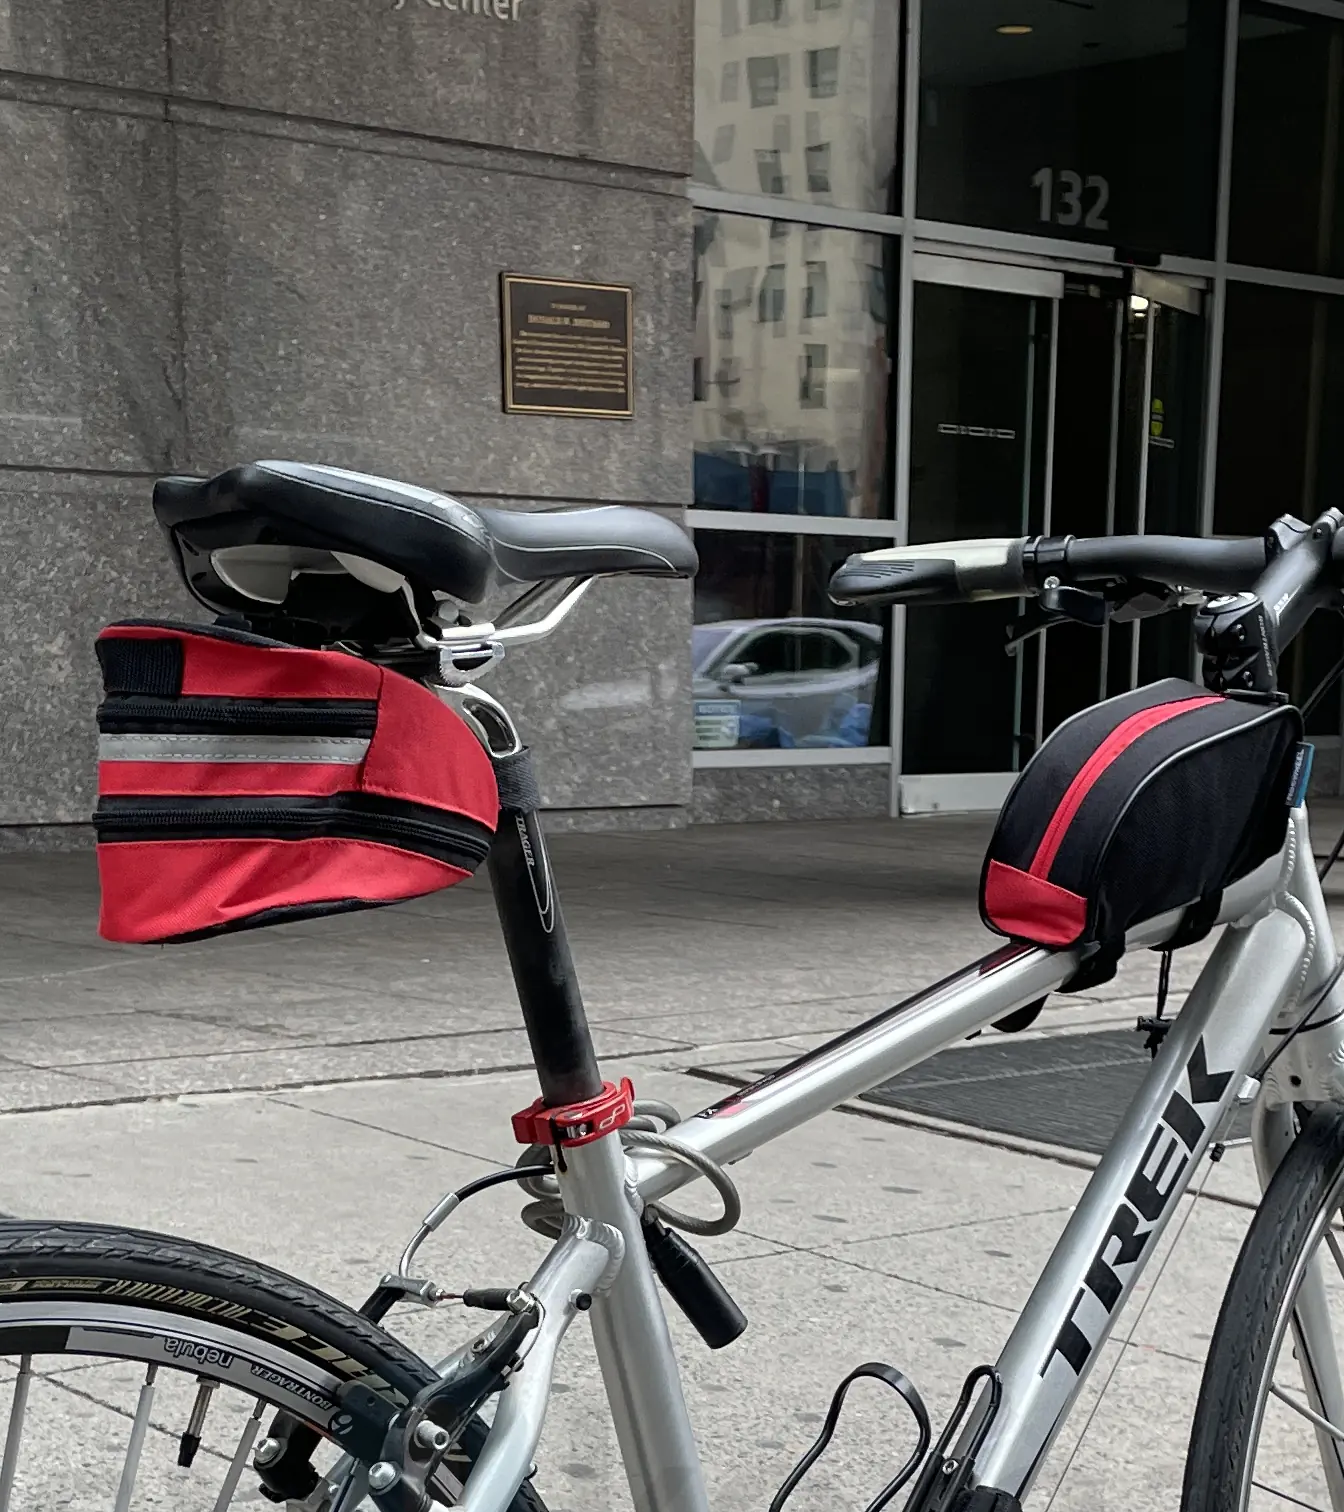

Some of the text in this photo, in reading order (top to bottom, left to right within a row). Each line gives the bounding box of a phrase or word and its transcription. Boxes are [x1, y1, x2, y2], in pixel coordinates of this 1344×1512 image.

[1030, 167, 1109, 230] 132
[515, 813, 535, 867] TRAGER
[1039, 1033, 1234, 1378] TREK
[163, 1336, 335, 1411] BONTRAGER nebula
